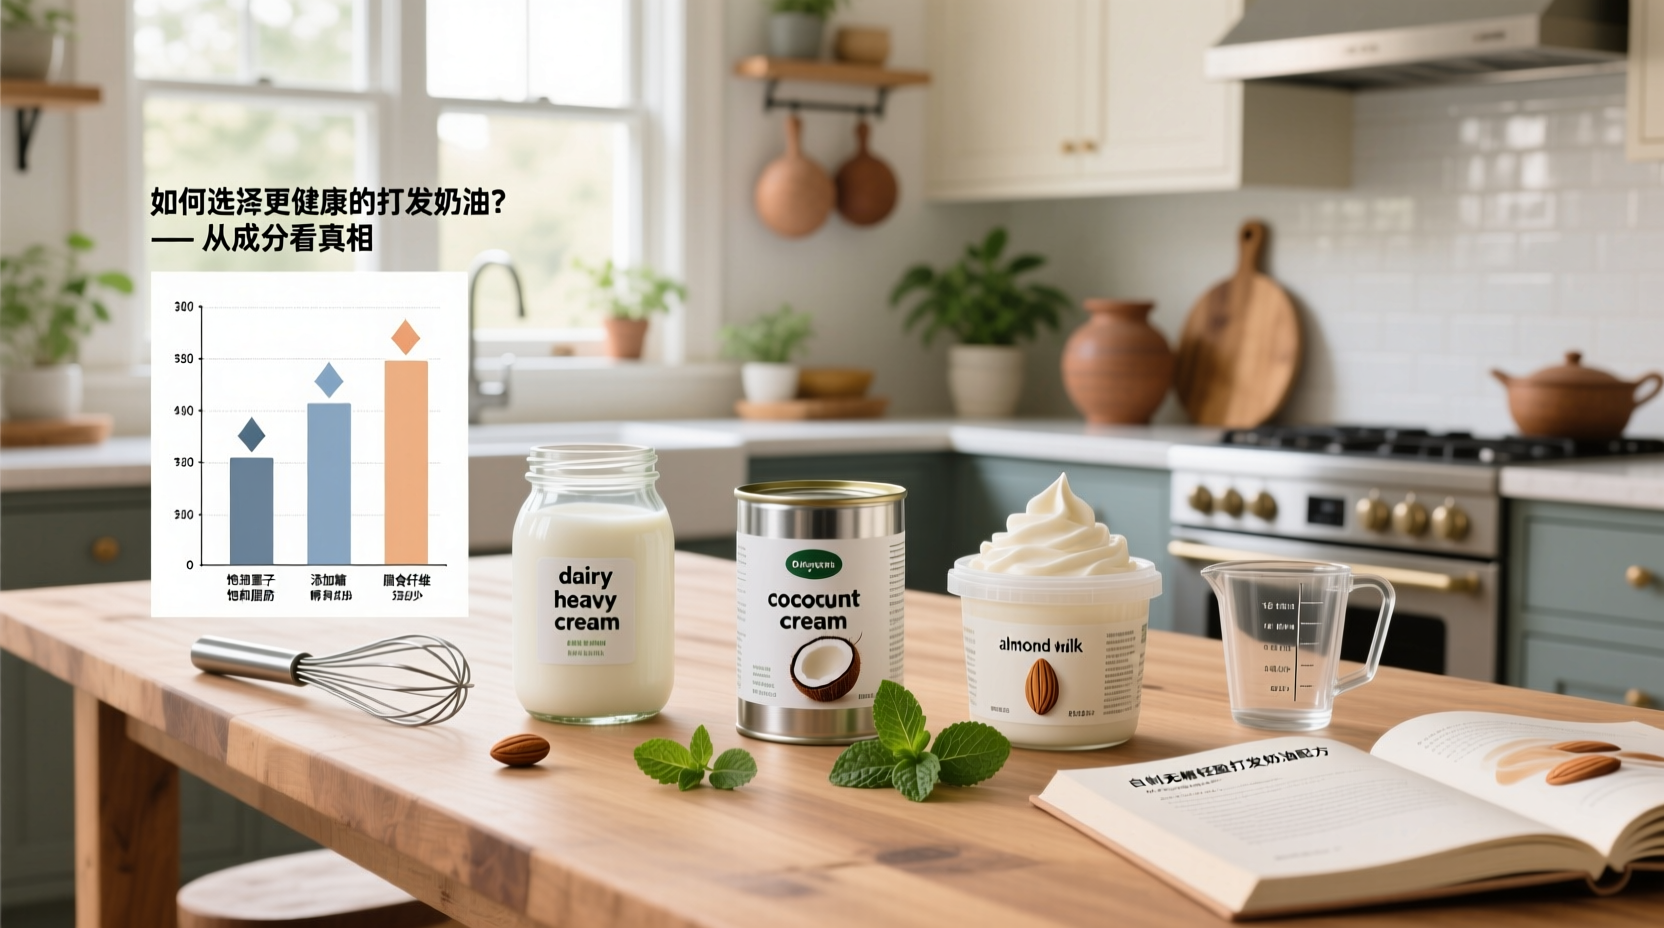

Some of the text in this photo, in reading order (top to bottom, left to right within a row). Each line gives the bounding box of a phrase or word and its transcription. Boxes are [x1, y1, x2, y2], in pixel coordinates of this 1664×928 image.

[559, 566, 613, 590] dairy
[554, 590, 617, 613] heavy
[554, 616, 620, 631] cream
[779, 615, 847, 630] cream
[999, 636, 1050, 653] almond
